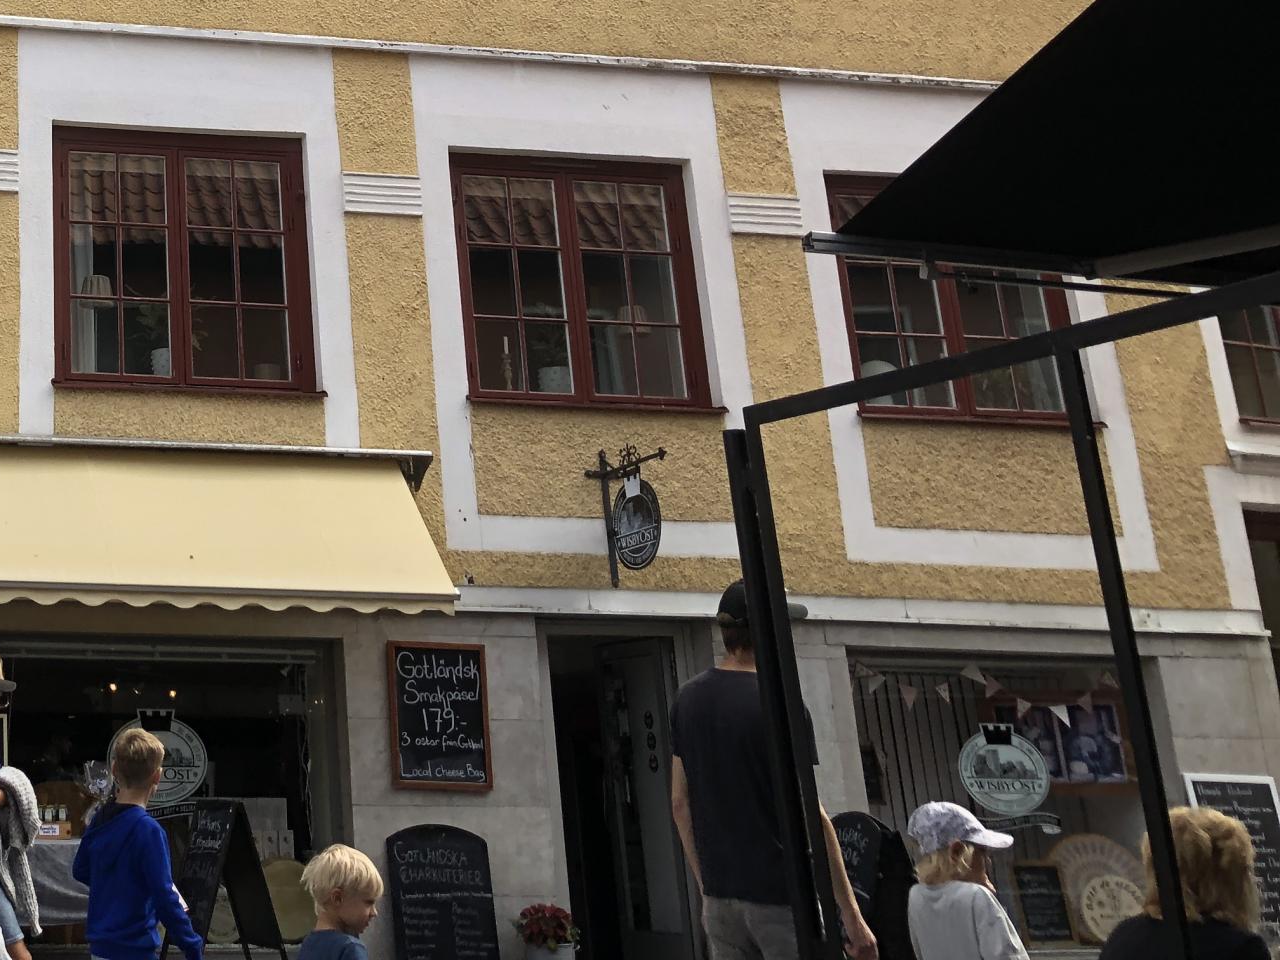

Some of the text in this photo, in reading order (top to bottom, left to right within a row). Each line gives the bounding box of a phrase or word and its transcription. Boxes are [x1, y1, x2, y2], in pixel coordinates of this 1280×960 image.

[397, 651, 480, 685] Gotländsk
[422, 707, 468, 734] 179:-
[401, 731, 411, 746] 3
[400, 754, 432, 777] Local
[466, 763, 486, 781] Bag
